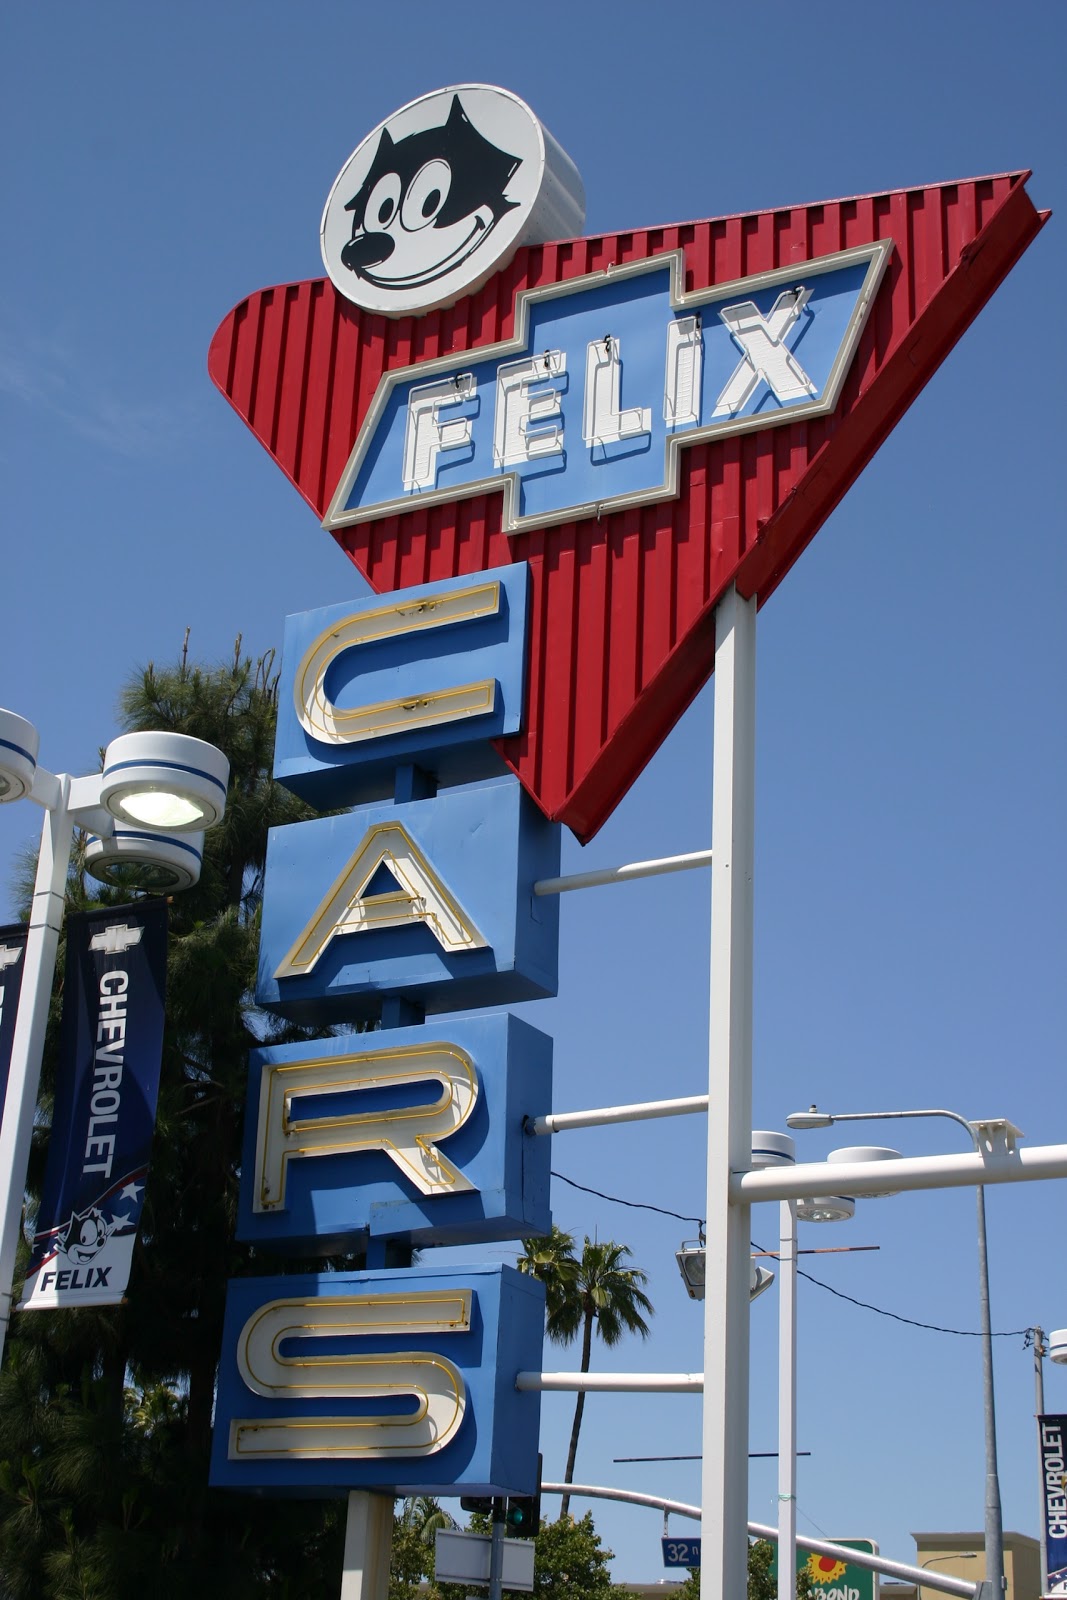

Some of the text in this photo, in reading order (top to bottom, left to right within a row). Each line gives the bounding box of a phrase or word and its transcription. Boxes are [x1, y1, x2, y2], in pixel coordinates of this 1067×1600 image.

[403, 285, 820, 492] FELIX
[83, 970, 129, 1178] CHEVROLET
[40, 1266, 112, 1292] FELIX
[1042, 1422, 1067, 1539] CHEVROLET
